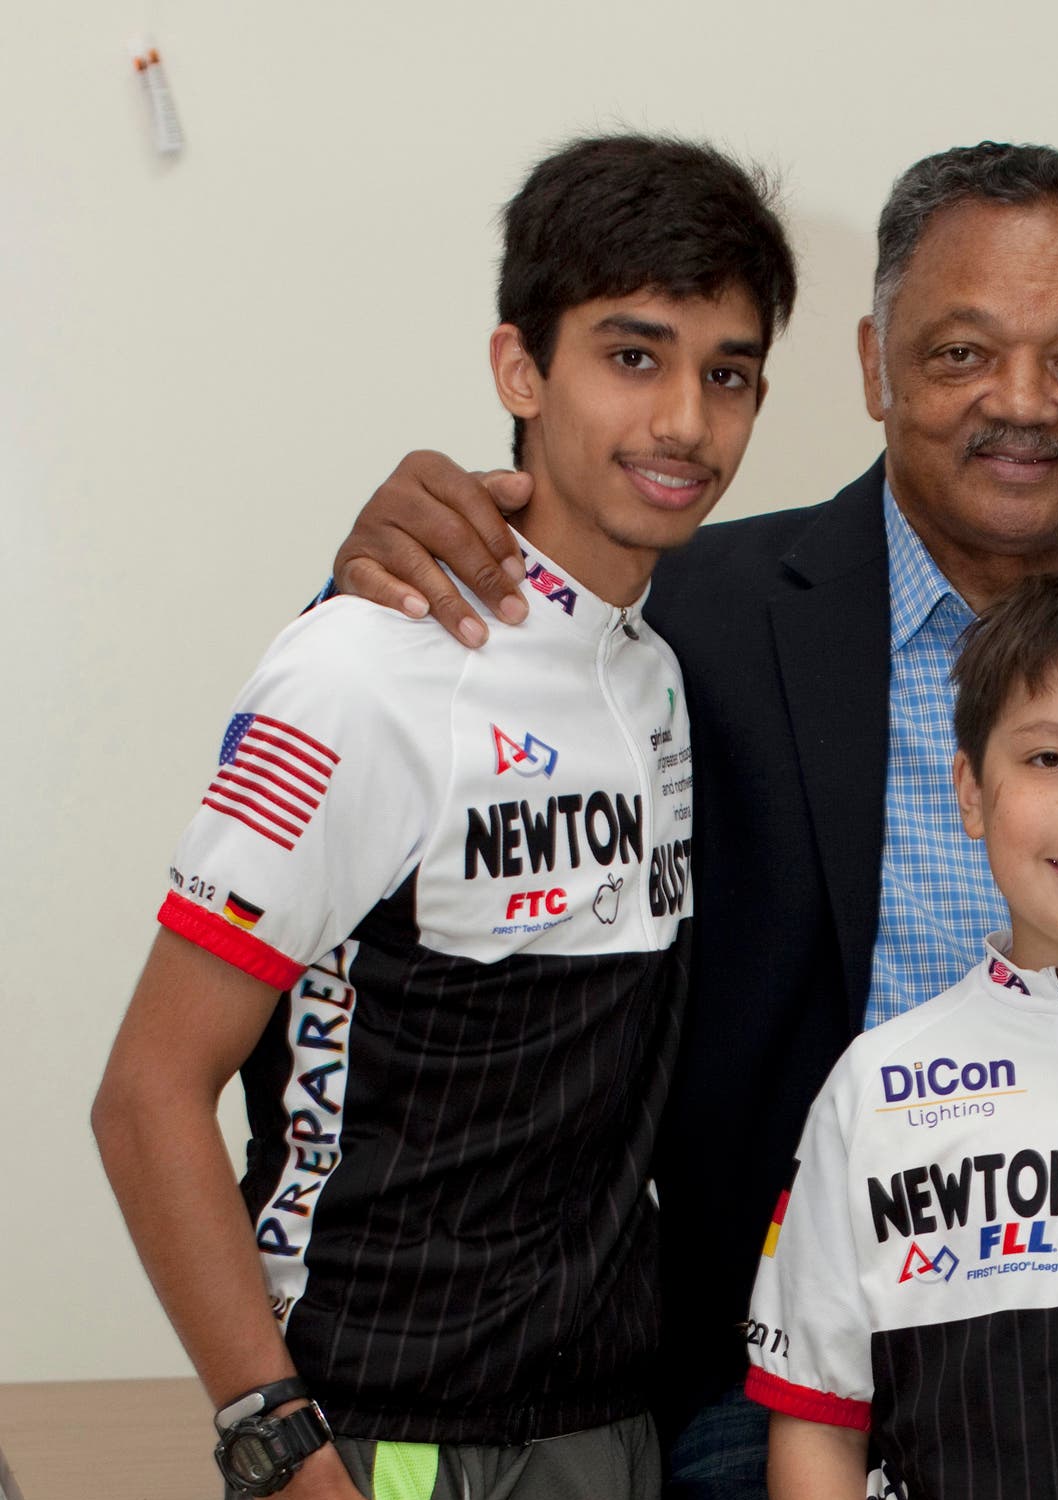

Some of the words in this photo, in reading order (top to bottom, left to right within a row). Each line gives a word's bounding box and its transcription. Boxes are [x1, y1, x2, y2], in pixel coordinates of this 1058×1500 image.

[465, 790, 644, 880] NEWTON
[505, 887, 567, 920] FTC
[523, 922, 541, 933] Tech
[881, 1057, 1016, 1103] DiCon
[908, 1101, 995, 1129] Lighting
[979, 1221, 1055, 1260] FLL
